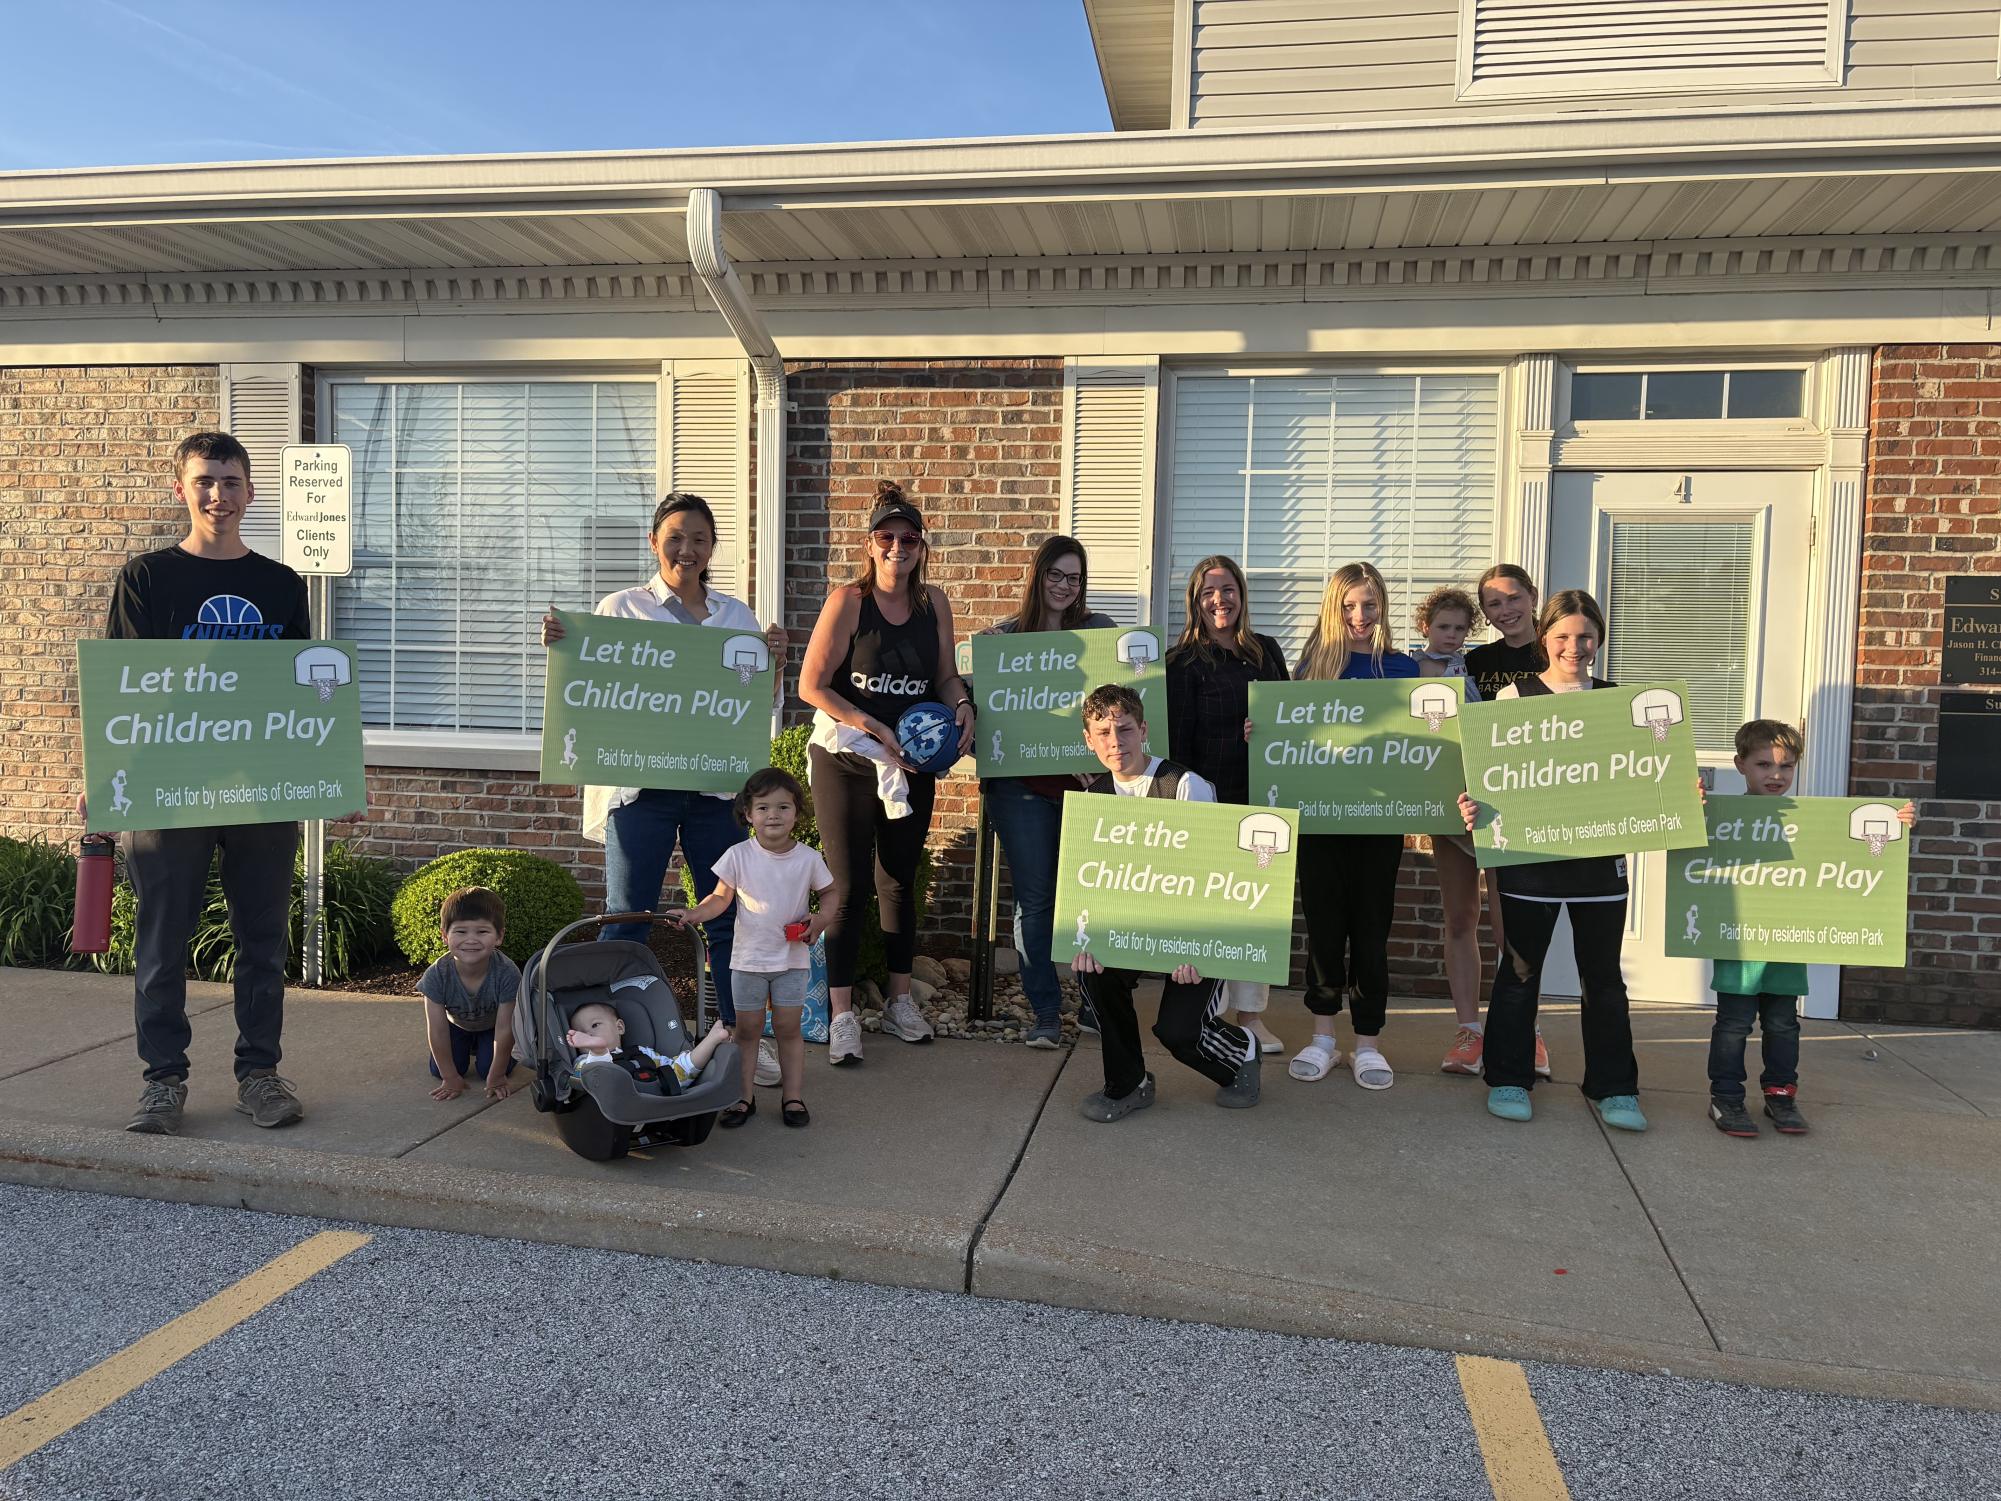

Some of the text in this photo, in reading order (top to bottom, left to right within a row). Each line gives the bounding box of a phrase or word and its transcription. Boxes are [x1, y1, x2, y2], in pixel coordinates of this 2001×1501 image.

[295, 460, 338, 473] Parking
[290, 476, 343, 487] Reserved
[1674, 475, 1692, 503] 4
[307, 492, 326, 503] For
[297, 529, 335, 540] Clients
[303, 546, 329, 559] Only
[182, 624, 284, 640] KNIGHTS
[1947, 640, 1974, 649] Jason
[1978, 641, 1988, 649] H.
[579, 637, 676, 668] Let the
[998, 648, 1077, 673] Let the
[120, 664, 238, 693] Let the
[850, 671, 929, 696] adidas
[564, 680, 751, 725] Children Play
[989, 686, 1085, 711] Children
[1276, 699, 1364, 724] Let the
[105, 710, 335, 746] Children Play
[1492, 715, 1584, 747] Let the
[597, 748, 749, 773] Paid for by residents of Green Park
[1020, 744, 1036, 758] Paid
[1039, 743, 1049, 757] for
[1051, 741, 1060, 760] by
[1265, 739, 1442, 771] Children Play
[1483, 751, 1671, 792] Children Play
[156, 780, 342, 809] Paid for by residents of Green Park
[1298, 801, 1444, 820] Paid for by residents of Green Park
[1093, 818, 1189, 849] Let the
[1526, 813, 1682, 845] Paid for by residents of Green Park
[1751, 815, 1799, 843] the
[1078, 861, 1270, 910] Children Play
[1685, 857, 1884, 896] Children Play
[1109, 930, 1267, 963] Paid for by residents of Green Park
[1720, 923, 1883, 945] Paid for by residents of Green Park
